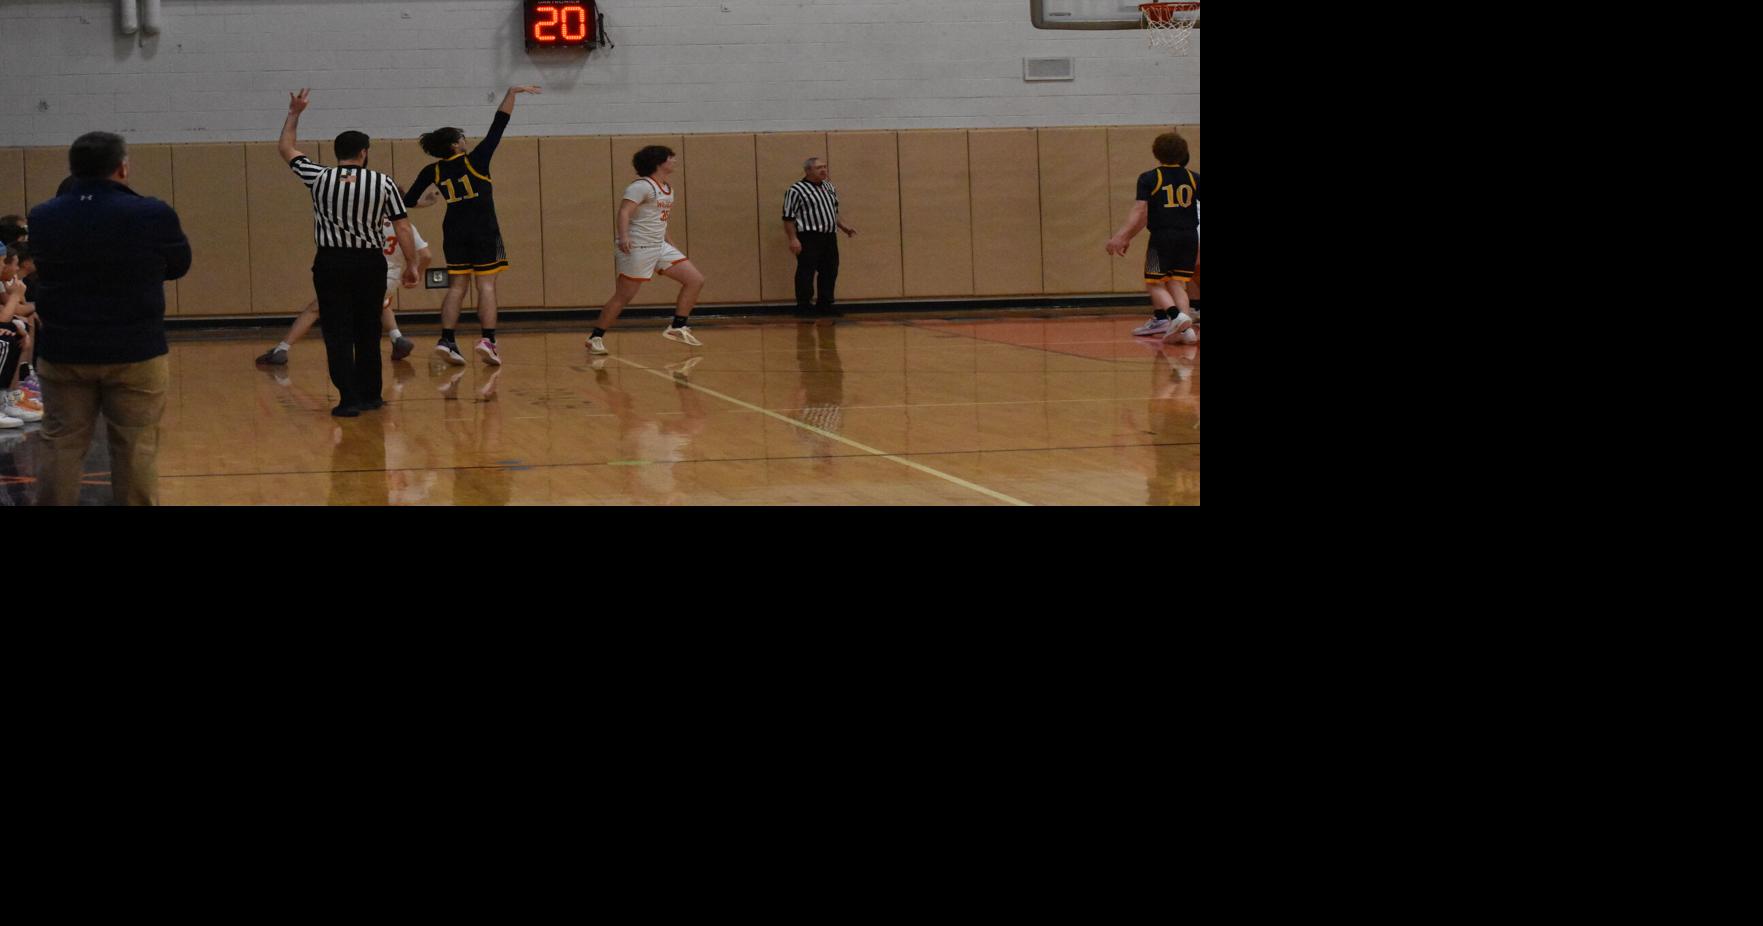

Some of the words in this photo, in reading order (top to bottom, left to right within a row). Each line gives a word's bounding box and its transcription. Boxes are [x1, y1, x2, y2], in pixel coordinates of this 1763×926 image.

[535, 6, 586, 40] 20
[440, 174, 479, 204] 11
[1161, 183, 1194, 208] 10
